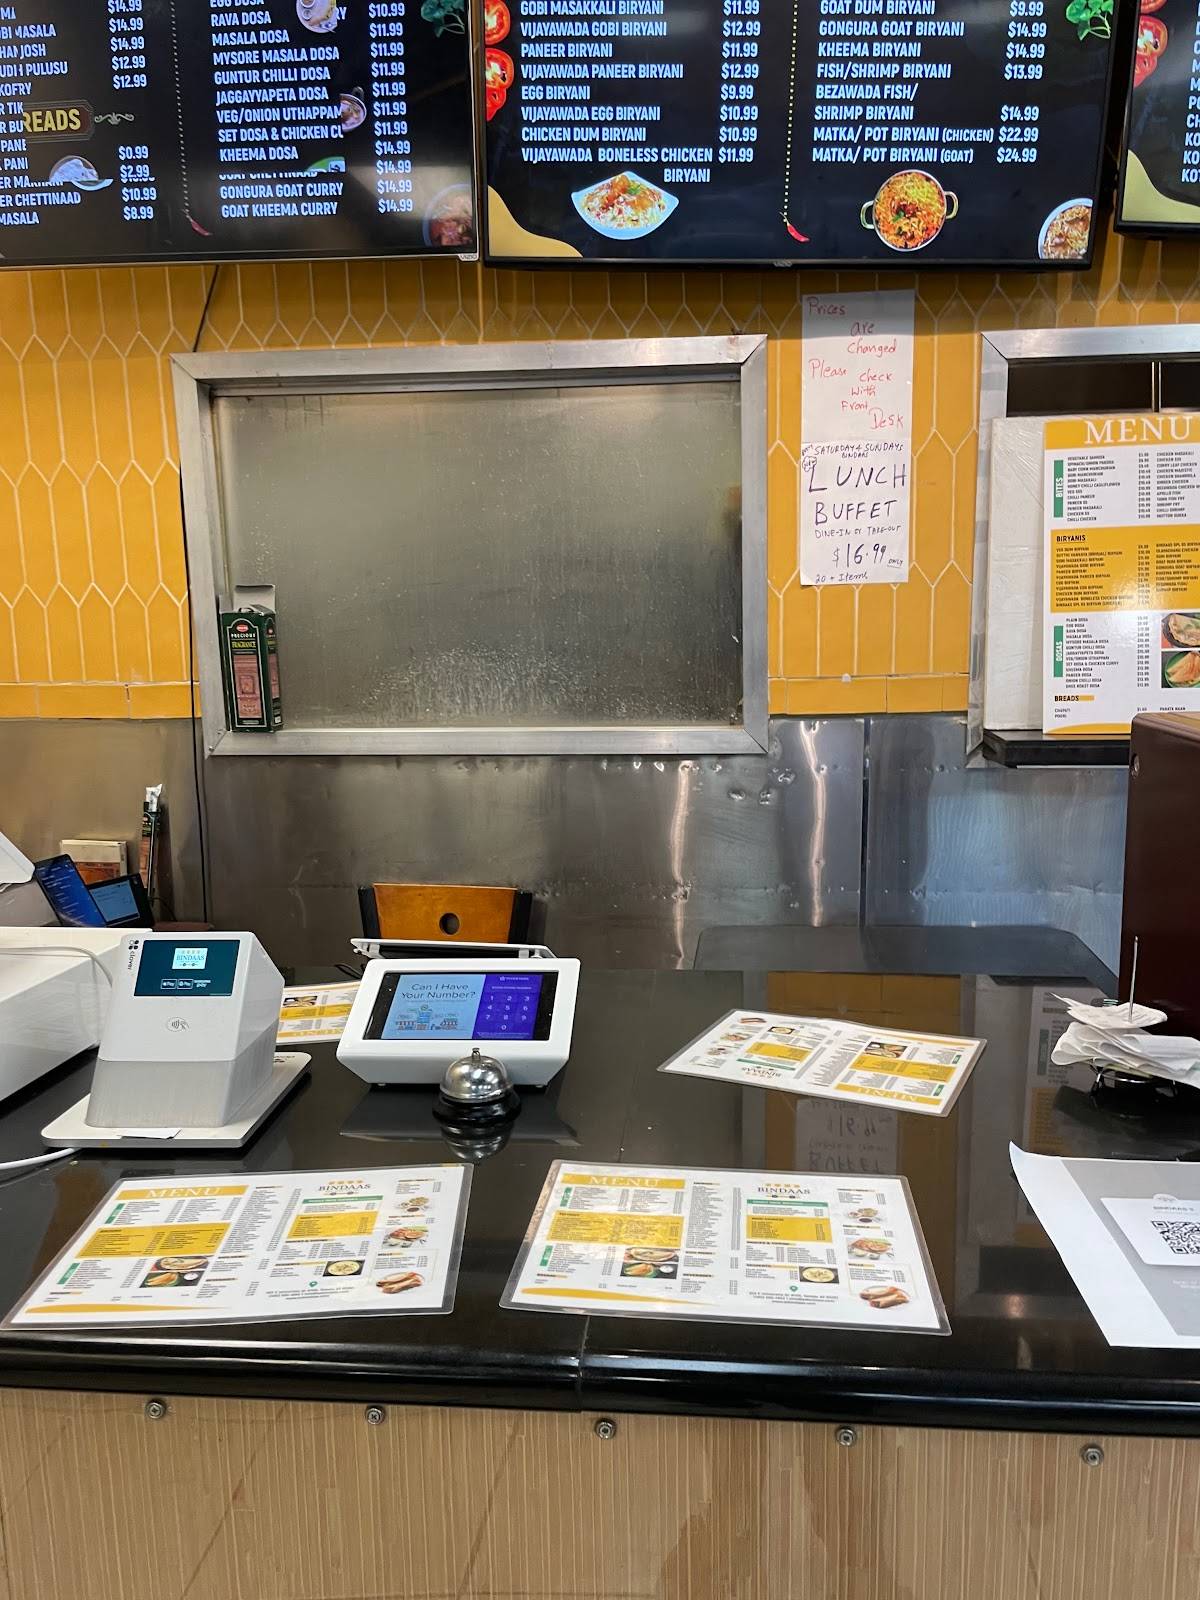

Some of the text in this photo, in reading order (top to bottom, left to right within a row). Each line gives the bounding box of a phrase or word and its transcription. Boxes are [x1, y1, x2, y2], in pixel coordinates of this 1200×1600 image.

[211, 3, 406, 27] RAVA DOSA $10.99
[520, 0, 759, 16] GOBI MASAKKALI BIRYANI $11.99
[820, 0, 1044, 17] GOAT DUM BIRYANI $9.99
[109, 17, 144, 33] $14.99
[520, 20, 761, 38] VIJAYAWADA GOBI BIRYANI $12.99
[819, 20, 1047, 39] GONGURA GOAT BIRYANI $14.99
[212, 23, 404, 46] MASALA DOSA $11.99
[110, 36, 145, 52] $14.99
[520, 42, 758, 59] PANEER BIRYANI $11.99
[818, 42, 1045, 59] KHEEMA BIRYANI $14.99
[213, 42, 404, 65] MYSORE MASALA DOSA $11.99
[26, 55, 146, 76] PULUSU $12.99
[214, 62, 405, 85] GUNTUR CHILLI DOSA $11.99
[520, 63, 759, 81] VIJAYAWADA PANEER BIRYANI $12.99
[816, 62, 1043, 80] FISH/SHRIMP BIRYANI $13.99
[113, 74, 148, 90] $12.99
[215, 82, 406, 106] JAGGAYYAPETA DOSA $11.99
[521, 84, 754, 101] EGG BIRYANI $9.99
[815, 83, 919, 101] BEZAWADA FISH/
[216, 109, 280, 124] VEG/ONION
[373, 101, 407, 117] $11.99
[521, 105, 758, 122] VIJAYAWADA EGG BIRYANI $10.99
[814, 105, 1040, 122] SHRIMP BIRYANI $14.99
[218, 121, 408, 143] SET DOSA & CHICKEN $11.99
[521, 126, 757, 143] CHICKEN DUM BIRYANI $10.99
[813, 125, 1039, 144] MATKA/ POT BIRYANI (CHICKEN) $22.99
[118, 145, 149, 160] $0.99
[220, 140, 411, 162] KHEEMA DOSA $14.99
[522, 147, 754, 164] VIJAYAWADA BONELESS CHICKEN $11.99
[812, 146, 1037, 164] MATKA/ POT BIRYANI (GOAT) $24.99
[376, 160, 412, 176] $14.99
[663, 168, 711, 183] BIRYANI
[15, 187, 157, 206] CHETTINAAD $10.99
[220, 180, 412, 200] GONGURA GOAT CURRY $14.99
[124, 206, 154, 220] $8.99
[222, 199, 413, 219] GOAT KHEEMA CURRY $14.99
[807, 296, 845, 316] Prices
[850, 322, 874, 336] are
[809, 359, 848, 379] Please
[841, 400, 868, 411] Front
[1084, 416, 1193, 445] MENU
[809, 464, 907, 493] LUNCH
[815, 500, 897, 526] BUFFET
[815, 529, 851, 539] DINE-IN
[1056, 534, 1086, 542] BIRYANIS
[427, 991, 476, 999] Number?
[318, 1184, 372, 1193] BINDAAS
[590, 1176, 661, 1187] MENU
[145, 1185, 224, 1199] MENU
